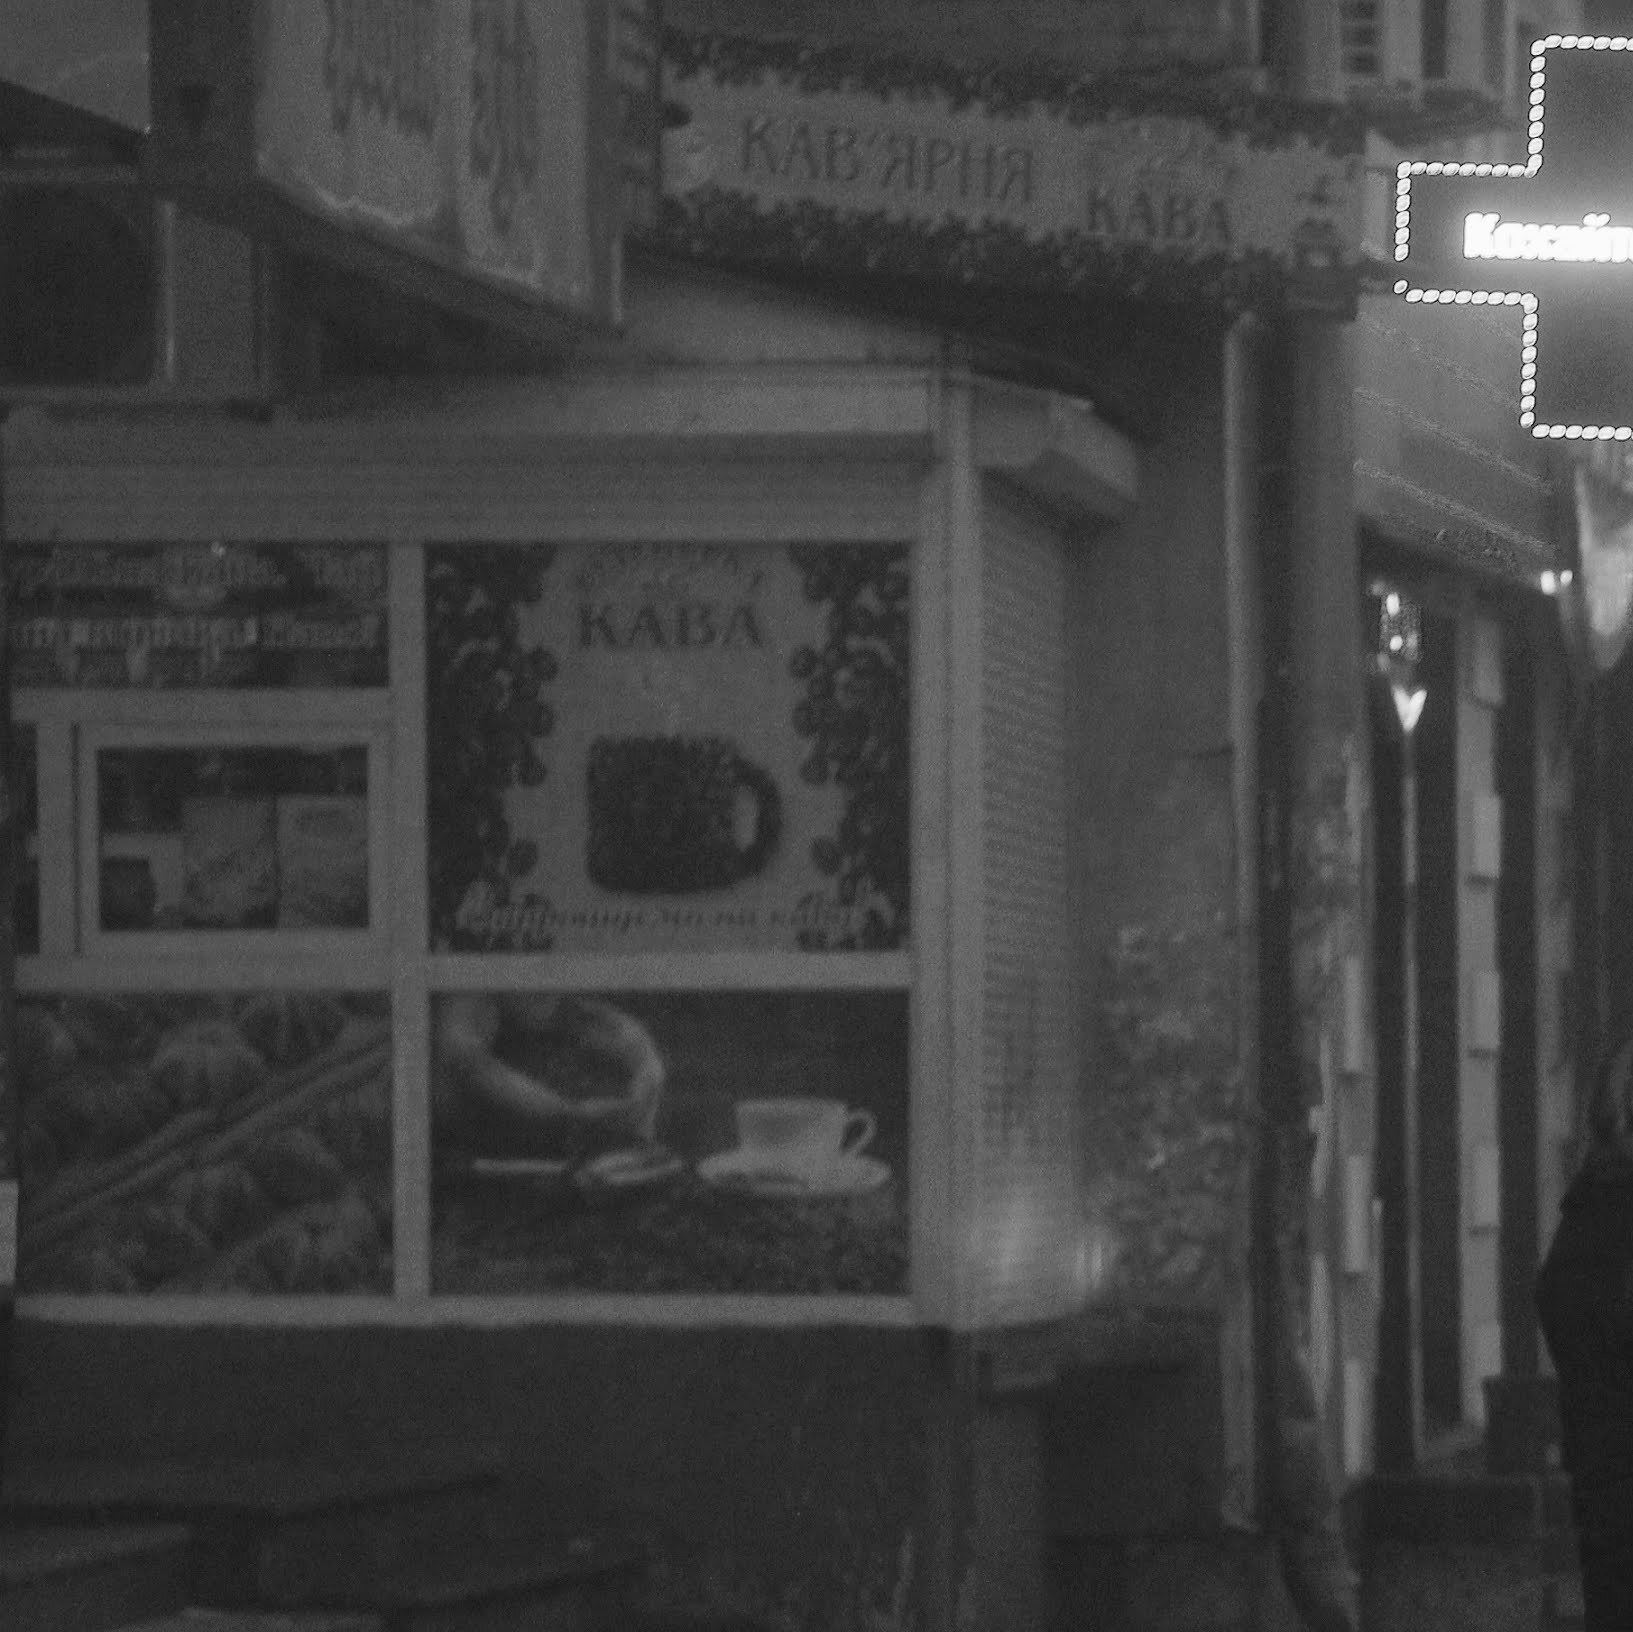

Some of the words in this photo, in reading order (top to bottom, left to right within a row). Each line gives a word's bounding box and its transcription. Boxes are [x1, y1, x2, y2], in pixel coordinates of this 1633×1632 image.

[740, 115, 1036, 203] КАВ'ЯРНЯ
[1085, 187, 1235, 244] КАВА
[579, 602, 764, 648] КАВА
